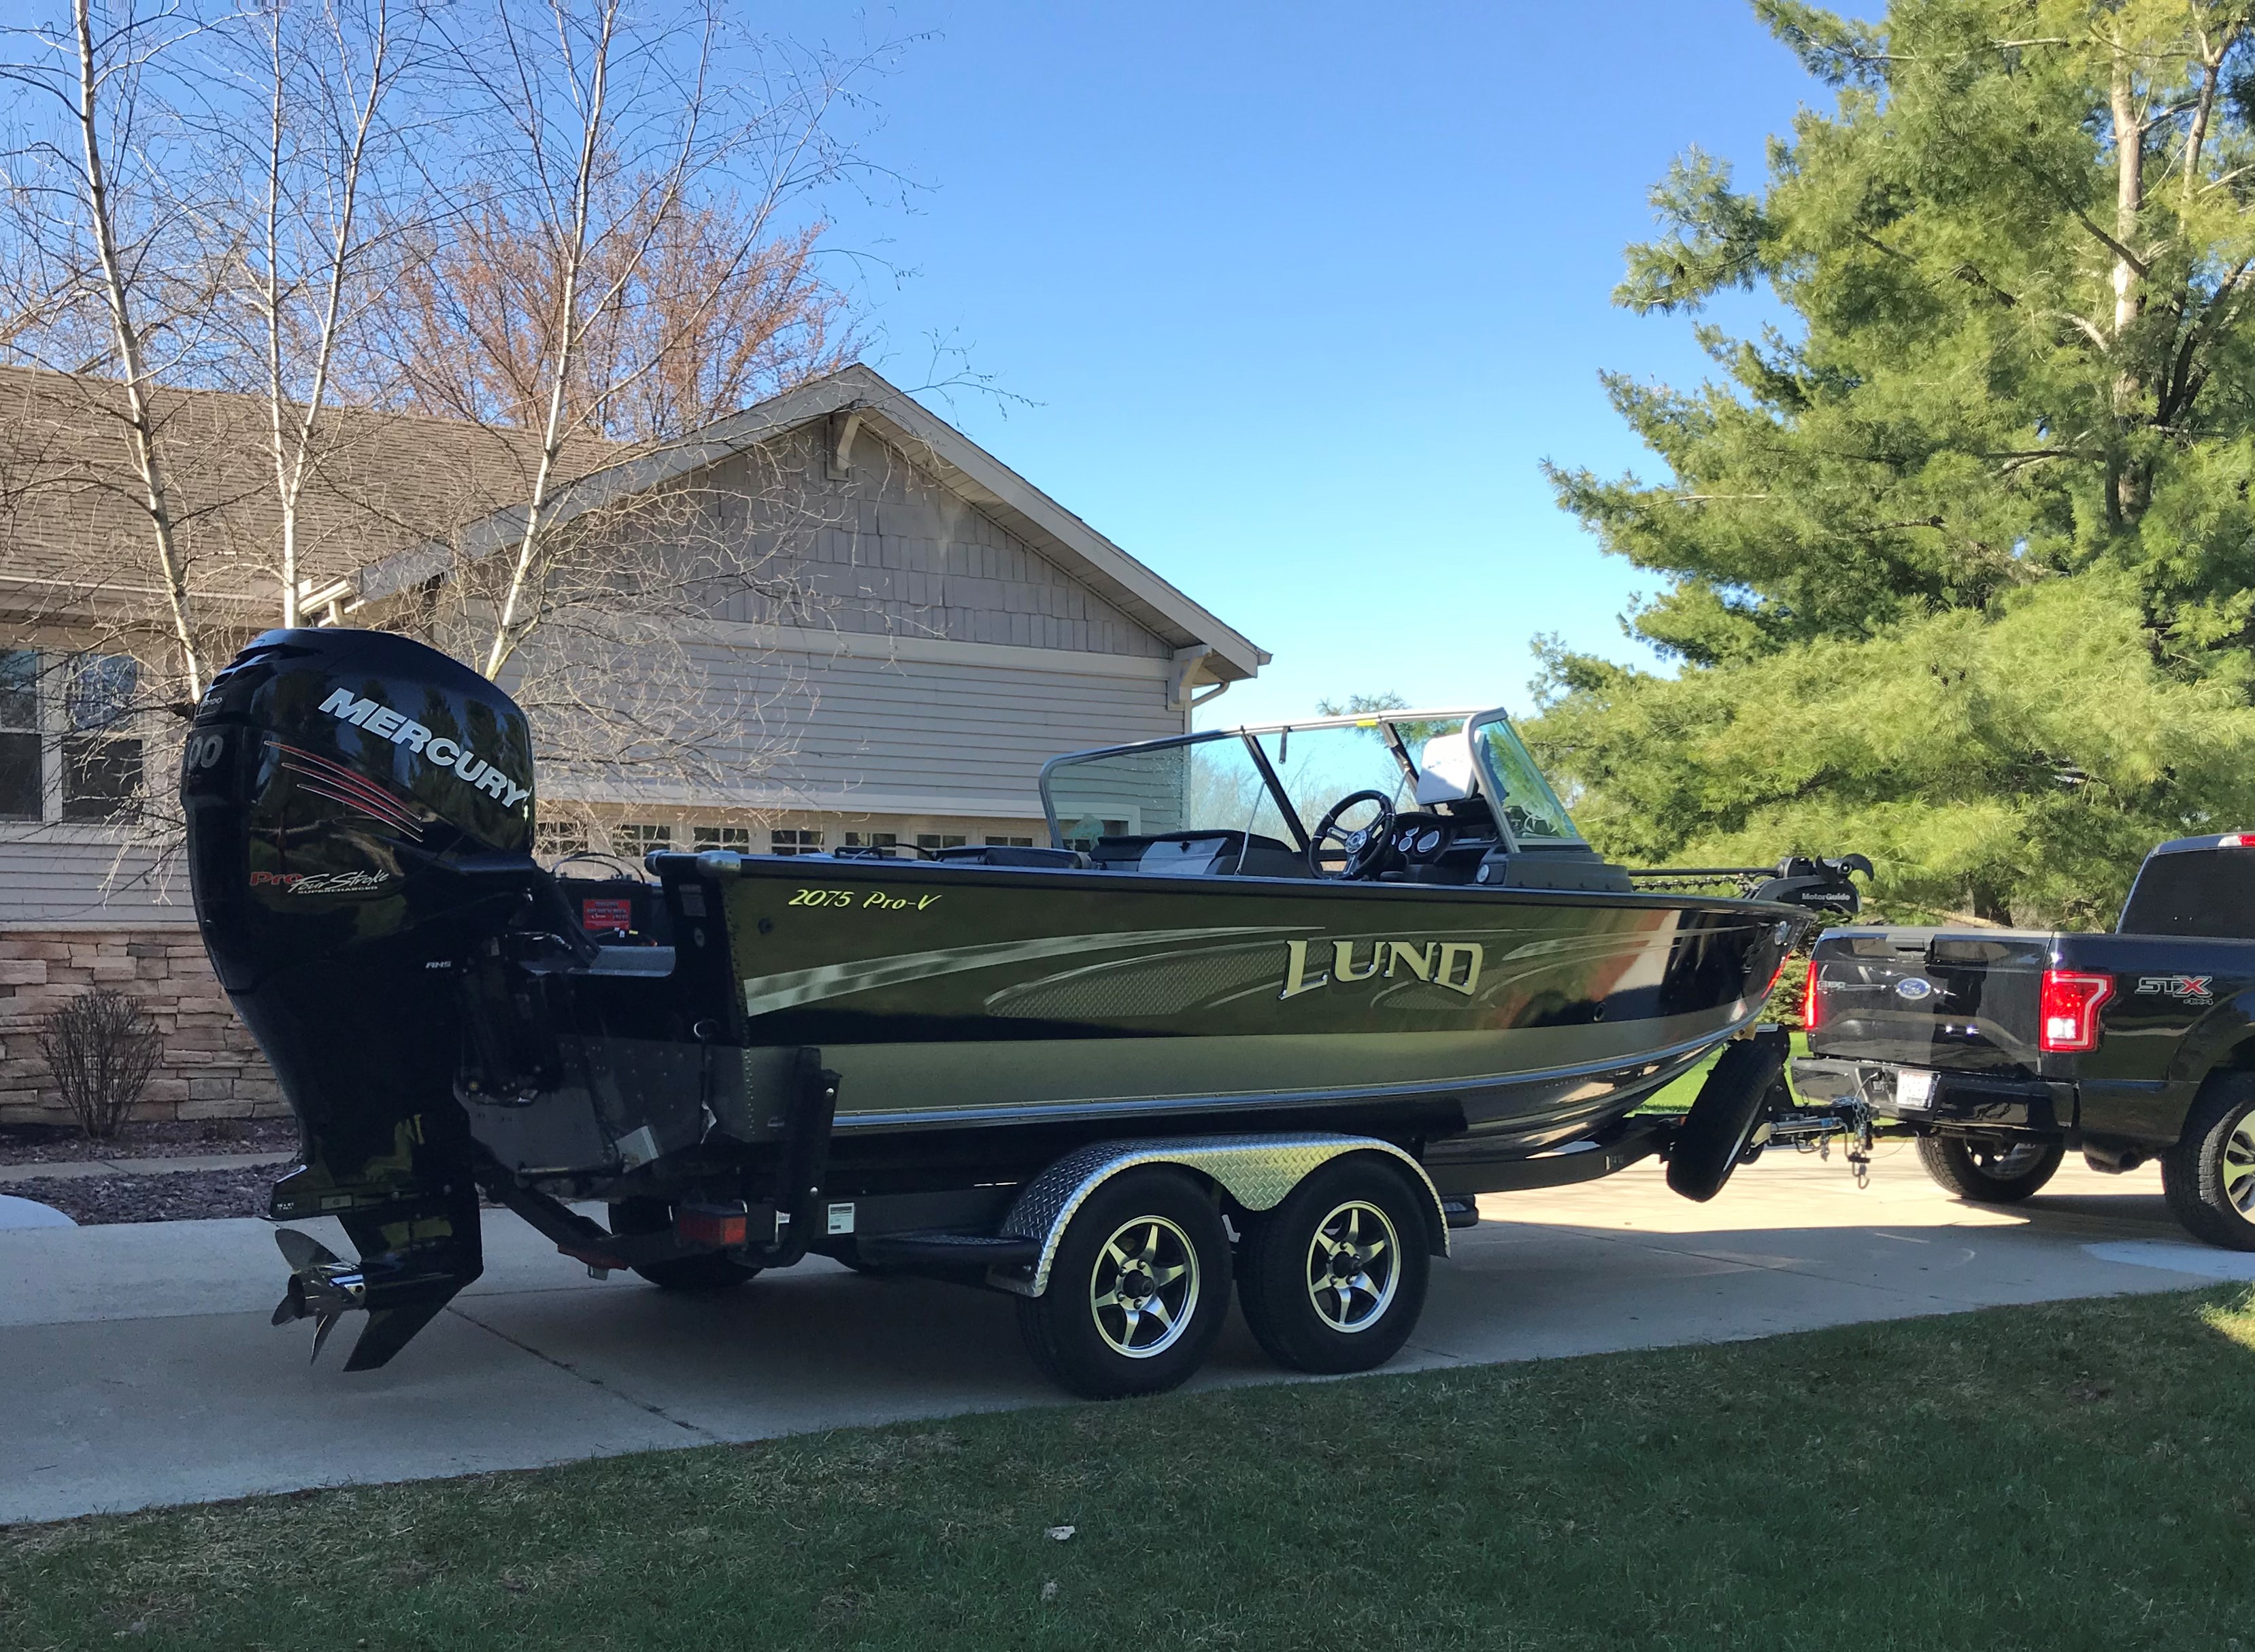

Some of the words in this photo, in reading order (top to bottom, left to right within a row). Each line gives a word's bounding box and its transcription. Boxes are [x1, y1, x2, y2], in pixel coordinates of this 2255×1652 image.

[318, 687, 533, 809] MERCURY
[250, 871, 304, 886] Pro
[298, 886, 378, 894] SUPERCHARGED
[788, 889, 855, 907] 2075
[863, 891, 943, 911] Pro-V
[1801, 892, 1850, 900] MotorGuide
[1277, 940, 1484, 1000] LUND
[2134, 975, 2214, 998] STX
